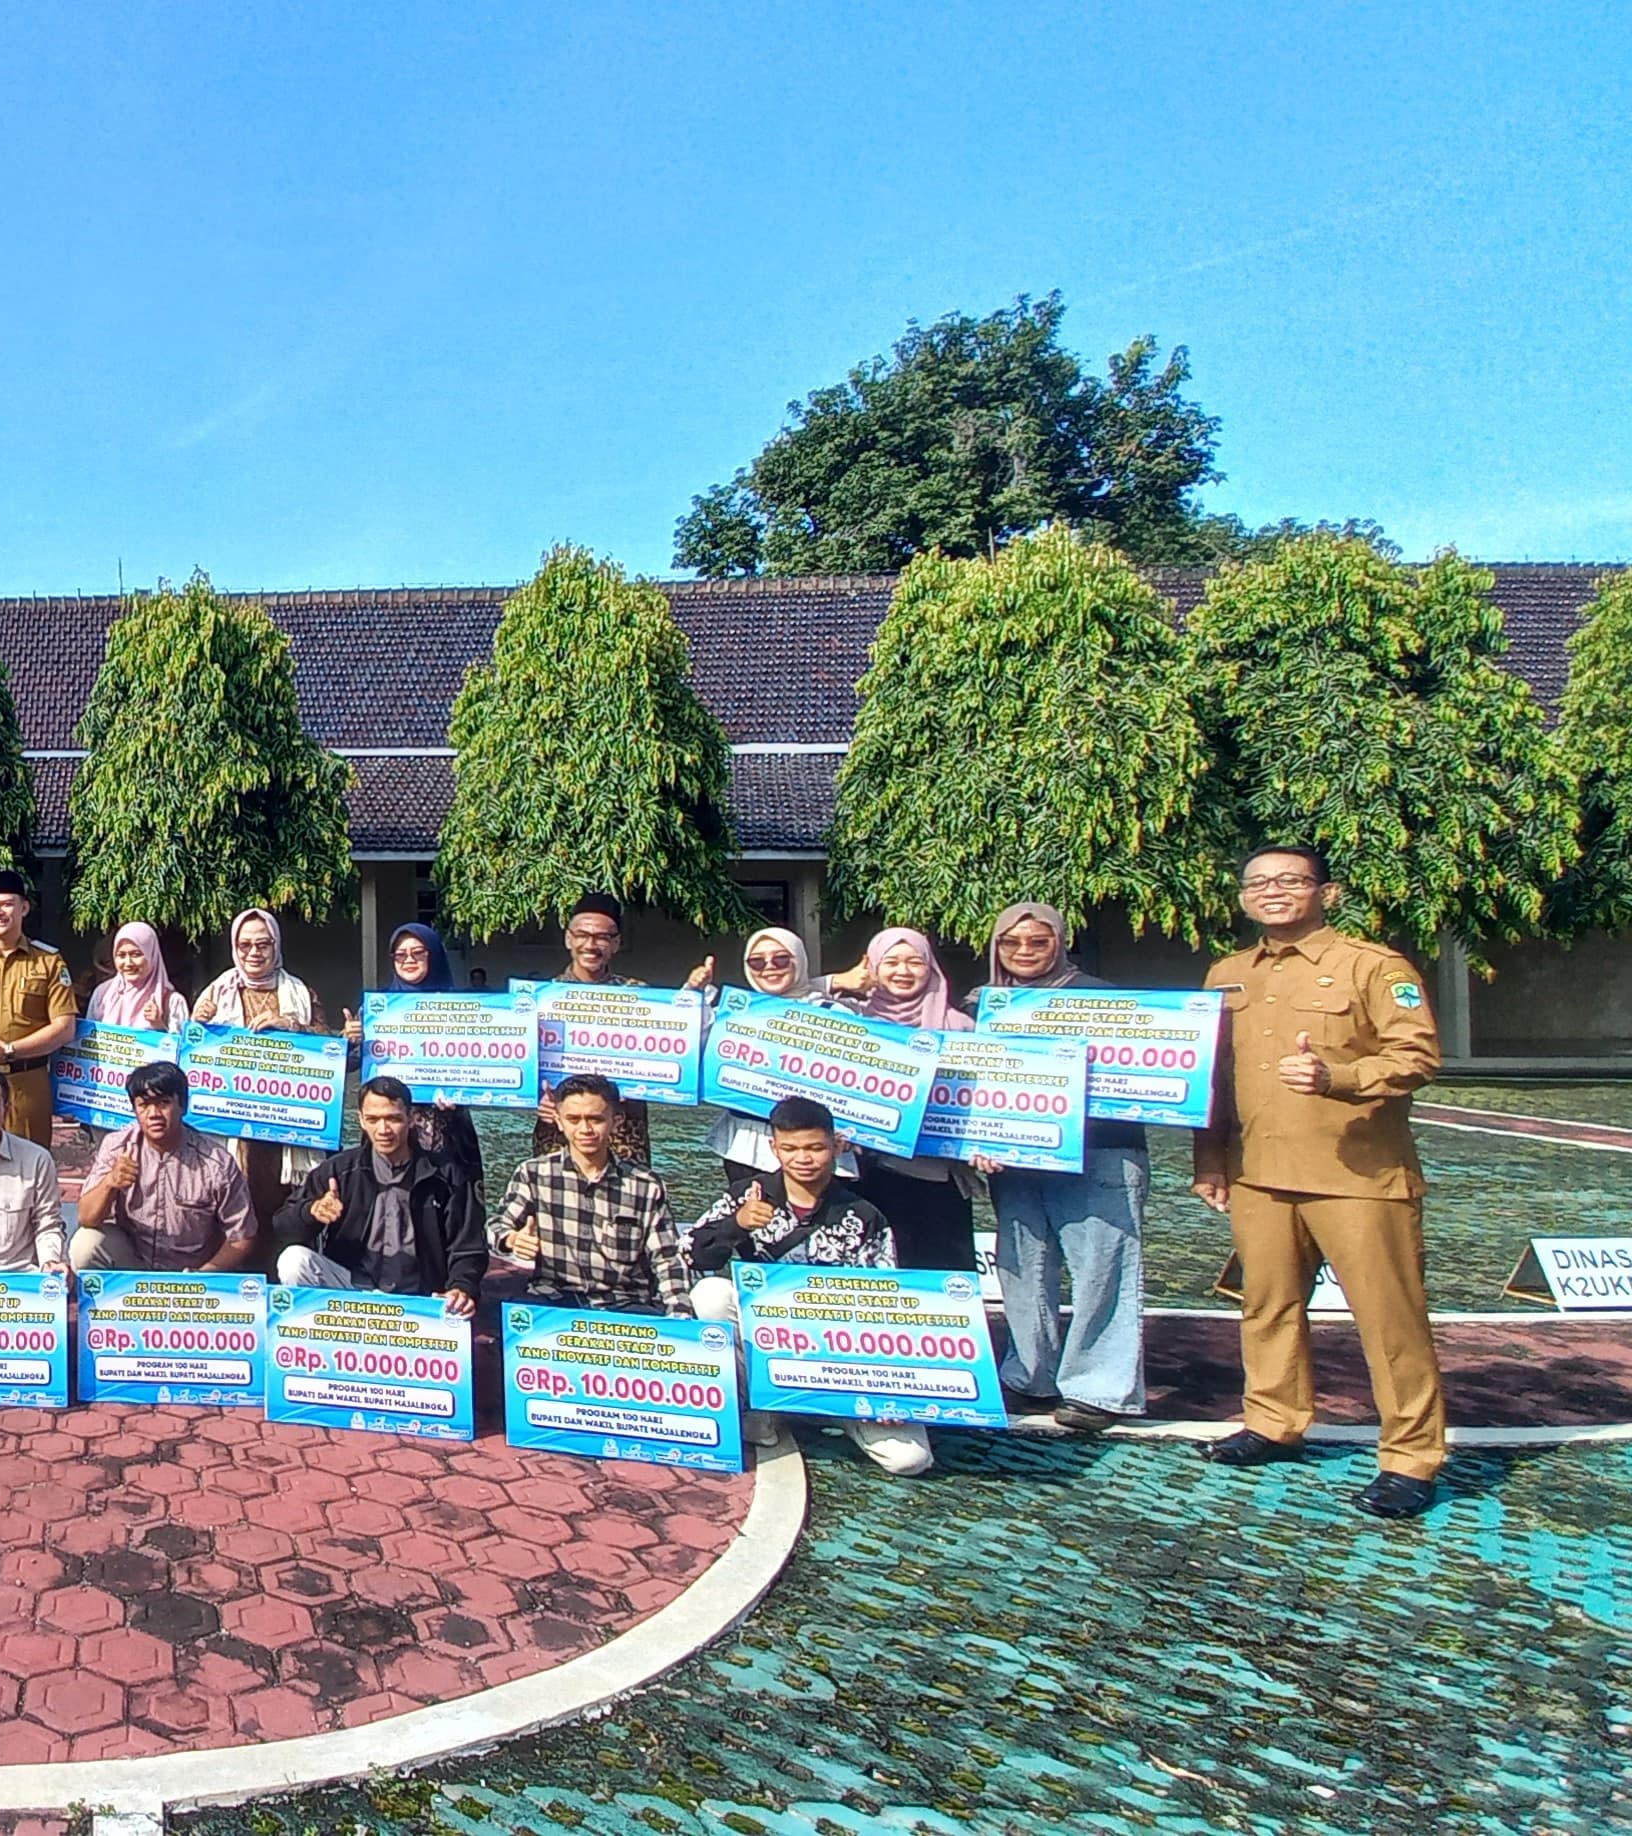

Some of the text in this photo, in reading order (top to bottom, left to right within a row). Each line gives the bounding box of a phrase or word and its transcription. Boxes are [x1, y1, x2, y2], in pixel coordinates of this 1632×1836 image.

[1048, 998, 1138, 1011] 25 PEMENANG
[785, 1009, 868, 1036] 25 PEMENANG
[1031, 1011, 1153, 1025] GERAKAN START UP
[568, 1030, 687, 1055] 10.000.000
[767, 1019, 880, 1053] GERAKAN START UP
[989, 1022, 1200, 1042] YANG INOVATIF DAN KOMPETITIF
[370, 1040, 526, 1060] @Rp. 10.000.000
[726, 1021, 920, 1076] YANG INOVATIF DAN KOMPETITIF
[1088, 1045, 1196, 1069] 000.000
[56, 1061, 85, 1081] @Rp.
[718, 1039, 913, 1102] @Rp. 10.000.000
[186, 1070, 333, 1102] @Rp. 10.000.000
[929, 1085, 1068, 1115] 0.000.000
[1552, 1249, 1632, 1269] DINAS
[807, 1276, 899, 1292] 25 PEMENANG
[328, 1300, 403, 1317] 25 PEMENANG
[793, 1292, 920, 1308] GERAKAN START UP
[314, 1314, 418, 1332] GERAKAN START UP
[751, 1305, 971, 1328] YANG INOVATIF DAN KOMPETITIF
[88, 1328, 255, 1351] @Rp. 10.000.000
[277, 1326, 457, 1351] YANG INOVATIF DAN KOMPETITIF
[571, 1320, 657, 1339] 25 PEMENANG
[557, 1334, 674, 1356] GERAKAN START UP
[753, 1326, 977, 1360] @Rp. 10.000.000
[276, 1345, 458, 1381] @Rp. 10.000.000
[516, 1346, 720, 1377] YANG INOVATIF DAN KOMPETITIF
[516, 1366, 722, 1408] @Rp. 10.000.000
